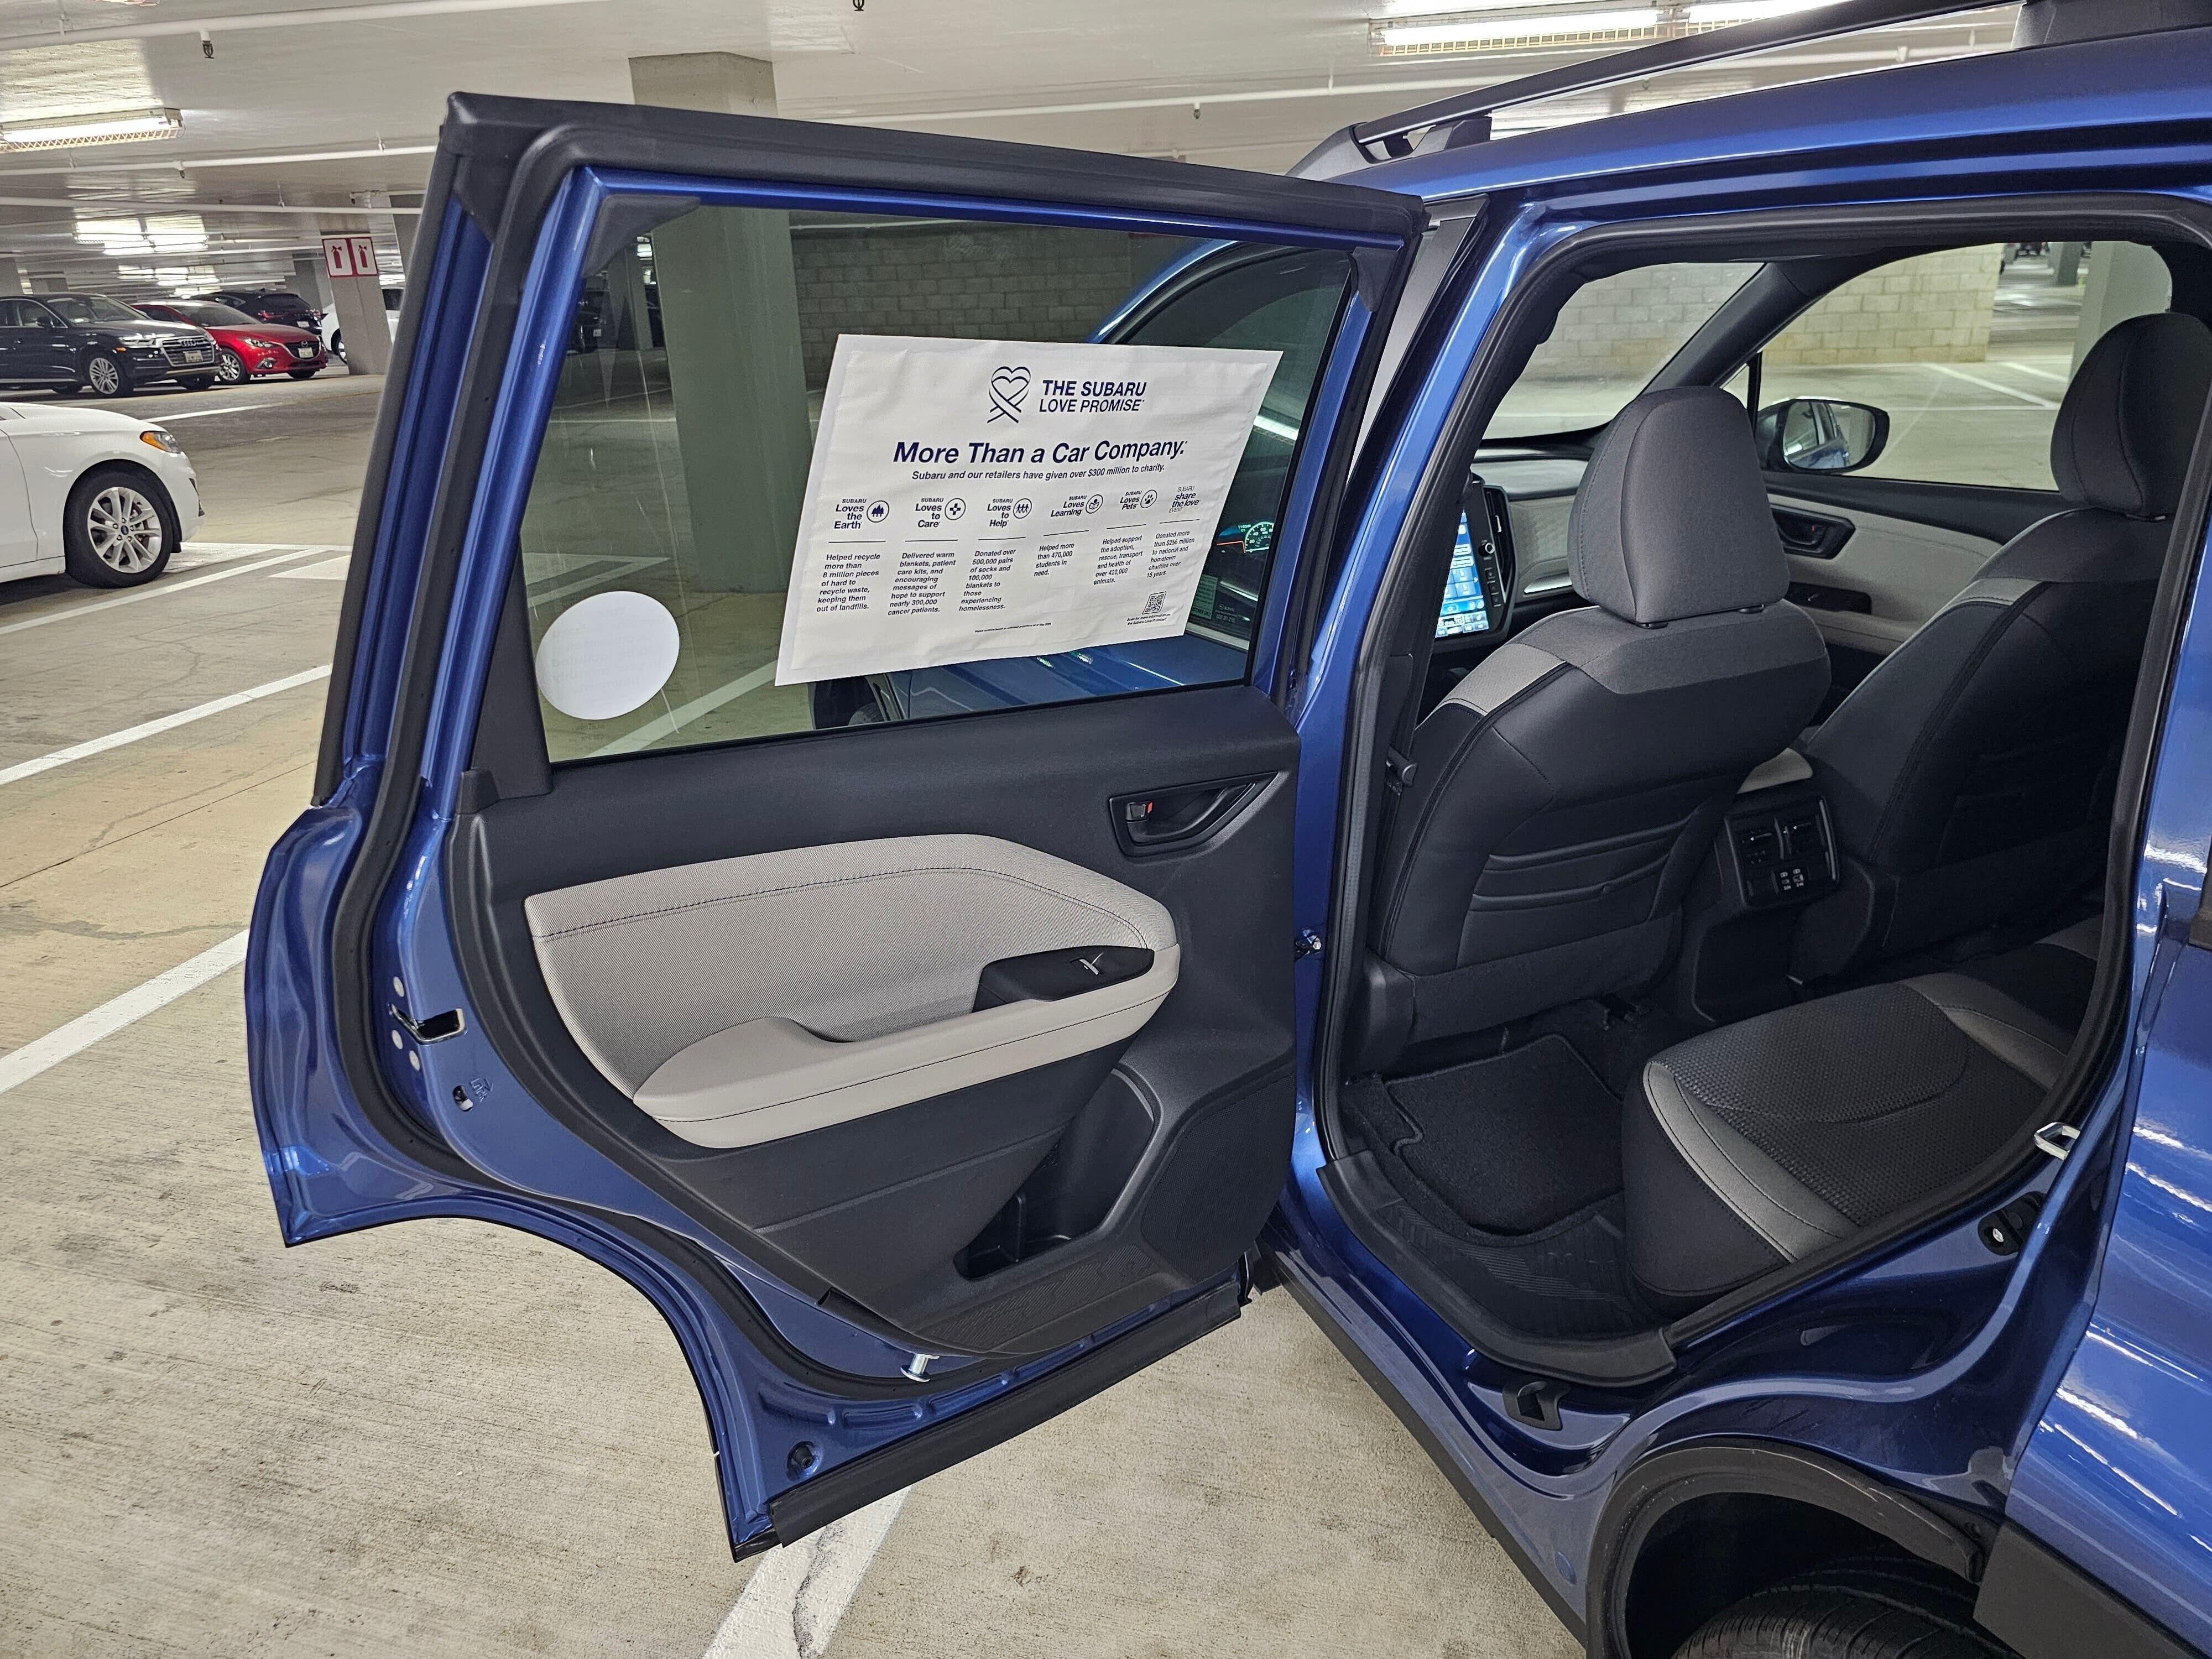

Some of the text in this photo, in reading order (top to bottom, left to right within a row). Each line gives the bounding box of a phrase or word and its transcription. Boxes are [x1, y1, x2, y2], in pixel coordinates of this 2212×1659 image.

[1042, 379, 1147, 397] THE SUBARU
[1039, 398, 1145, 413] LOVE PROMISE
[893, 441, 959, 463] More
[968, 442, 1025, 463] Than
[1030, 448, 1045, 463] a
[1052, 442, 1091, 463] Car
[912, 471, 947, 479] Subaru
[947, 471, 966, 479] and
[984, 470, 1021, 479] retailers
[1022, 471, 1044, 479] have
[1045, 471, 1068, 481] given
[1088, 468, 1105, 477] $300
[1106, 466, 1130, 475] million
[1140, 463, 1165, 473] charity.
[1174, 492, 1196, 500] share
[835, 504, 864, 512] Loves
[915, 503, 942, 512] Loves
[987, 503, 1011, 512] Loves
[847, 512, 863, 520] the
[1050, 508, 1084, 518] Learning
[834, 520, 863, 529] Earth
[917, 519, 941, 528] Care
[989, 519, 1009, 529] Help
[1155, 531, 1177, 539] Donated
[1102, 535, 1142, 545] Helped support
[1039, 544, 1060, 552] Helped
[1110, 544, 1134, 552] adoption,
[826, 553, 880, 562] Helped recycle
[1051, 550, 1073, 559] 470,000
[931, 560, 956, 568] patient
[998, 557, 1014, 565] pairs
[1036, 560, 1061, 568] students
[1148, 562, 1169, 571] charities
[855, 570, 879, 578] pieces
[1108, 567, 1128, 576] 420,000
[820, 588, 846, 596] recycle
[817, 596, 847, 604] keeping
[961, 596, 1002, 605] experiencing
[911, 607, 940, 615] patients.
[471, 1078, 487, 1102] LOCK
